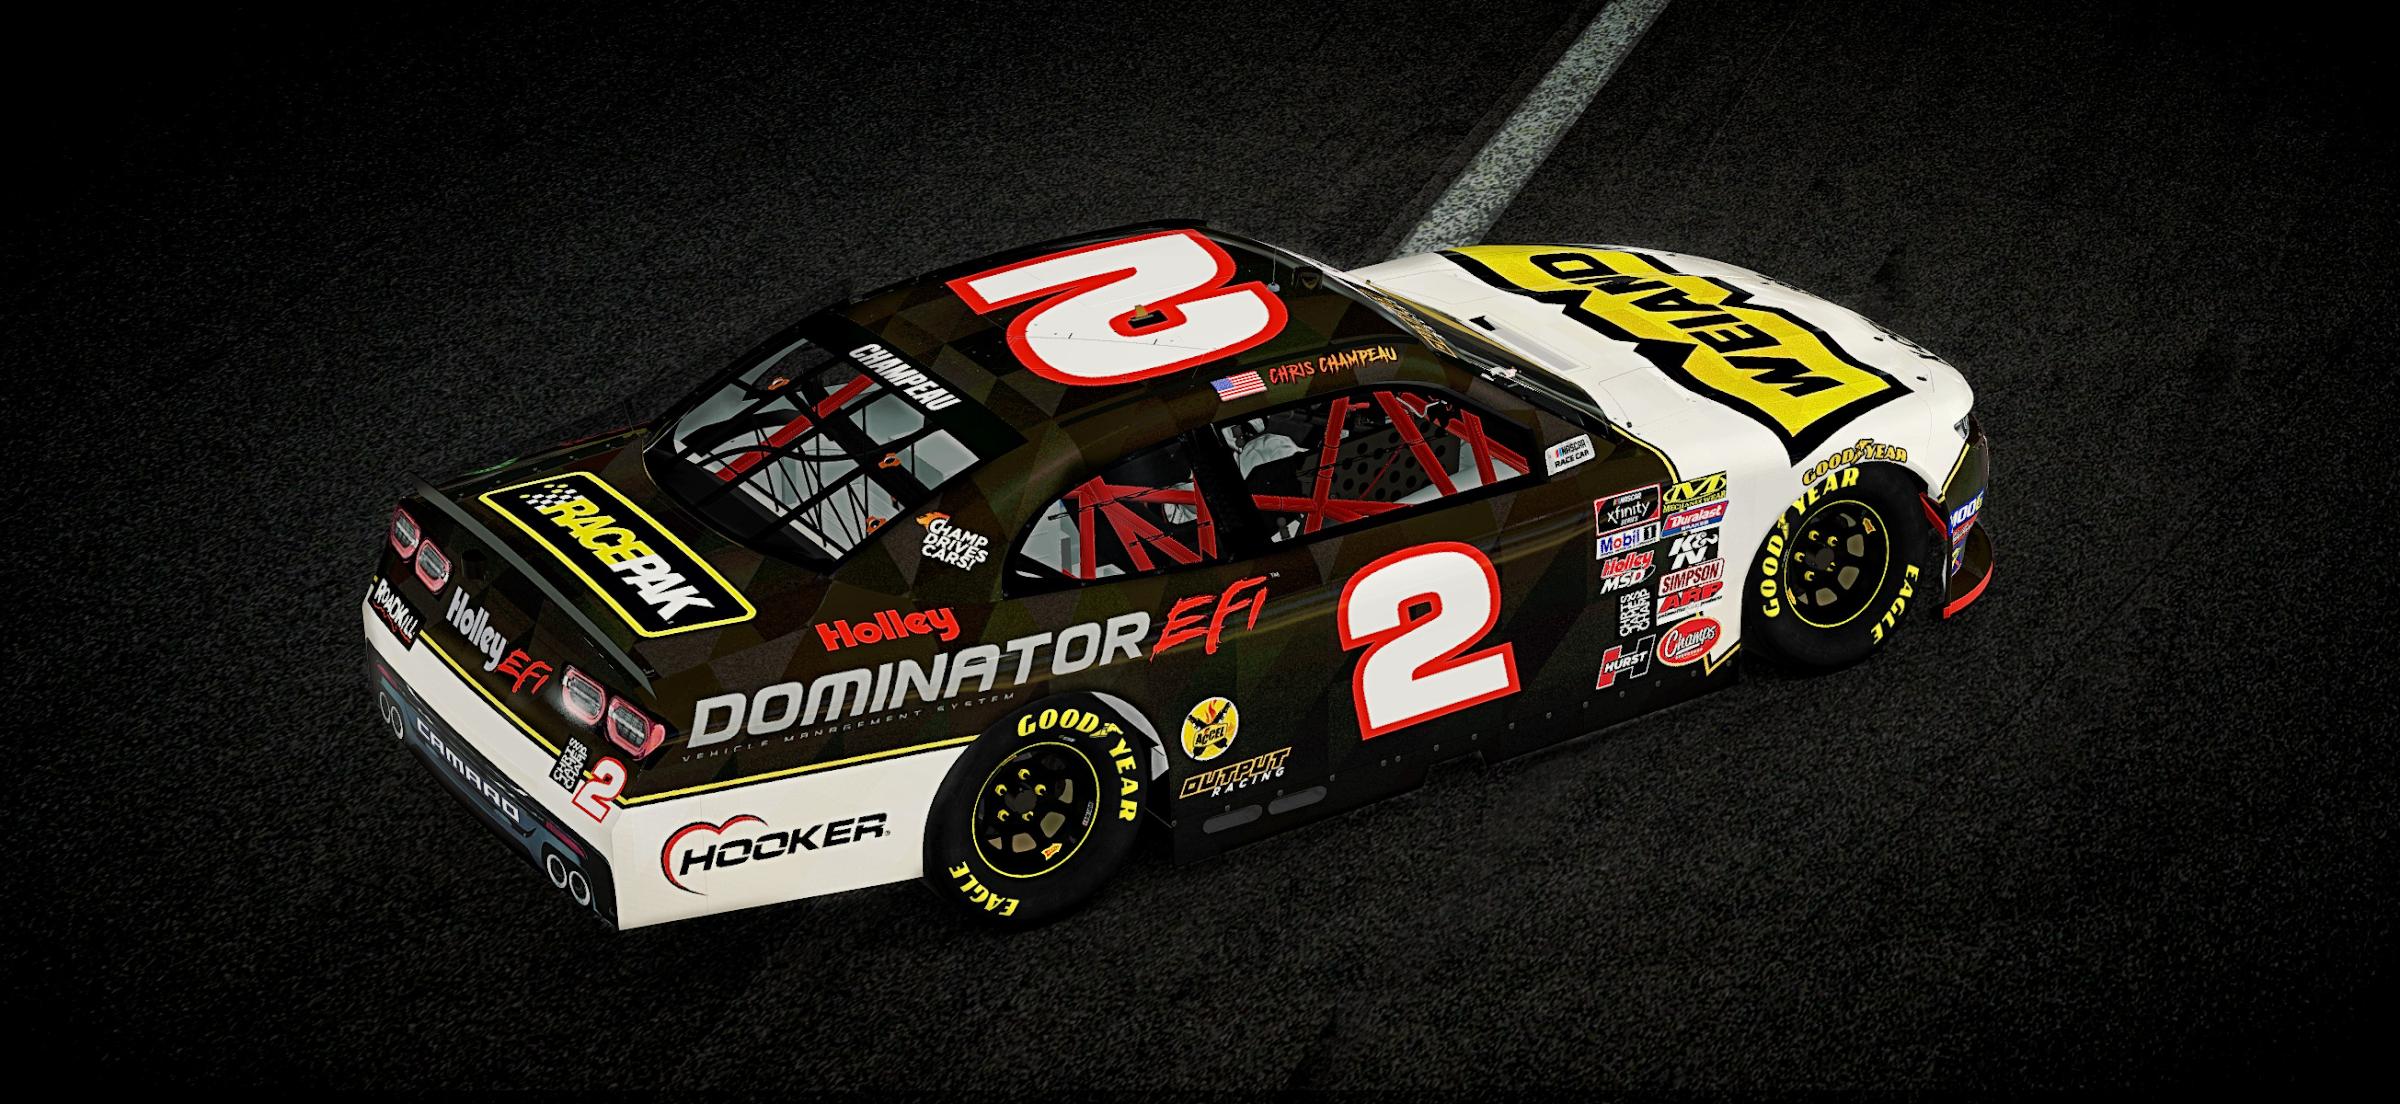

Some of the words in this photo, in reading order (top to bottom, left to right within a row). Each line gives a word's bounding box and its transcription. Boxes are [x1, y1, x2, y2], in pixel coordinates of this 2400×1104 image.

[946, 229, 1288, 387] 2
[1529, 252, 1845, 398] WEIAND
[849, 343, 961, 411] CHAMPEAU
[1269, 361, 1315, 385] CHRIS
[1319, 345, 1398, 373] CHAMPEAU
[1554, 455, 1575, 468] RACE
[1575, 449, 1589, 460] CAR
[929, 519, 989, 548] CHAMP
[1607, 501, 1650, 524] xfinity
[1671, 504, 1723, 528] Duralast
[543, 495, 716, 621] RACEPAK
[921, 544, 976, 571] CARS!
[923, 532, 989, 563] DRIVES
[1600, 528, 1640, 554] Mobil
[1600, 550, 1655, 579] Holley
[1600, 569, 1647, 594] MSD
[1662, 561, 1720, 594] SIMPSON
[374, 578, 419, 639] ROADKILL
[1619, 594, 1630, 637] CHRIS
[1628, 590, 1641, 634] JAMES
[1638, 588, 1650, 631] CHAMP
[1659, 582, 1723, 613] ARP
[1871, 564, 1920, 645] EAGLE
[446, 585, 507, 672] Holley
[815, 607, 961, 652] Holley
[1337, 540, 1521, 741] 2
[1664, 625, 1716, 658] Champs
[686, 611, 1151, 748] DOMINATOR
[1604, 651, 1648, 673] HURST
[682, 740, 769, 762] VEHICLE
[784, 711, 922, 743] MANAGEMENT
[936, 693, 1015, 711] SYSTEM
[1194, 726, 1225, 746] ACCEL
[416, 717, 520, 824] CAMARO
[553, 737, 578, 781] CHRIS
[564, 746, 588, 790] CHAMP
[1179, 747, 1292, 799] OUTPUT
[571, 756, 628, 823] 2
[1211, 767, 1285, 798] RACING
[679, 813, 888, 875] HOOKER
[948, 861, 1020, 916] EAGLE
